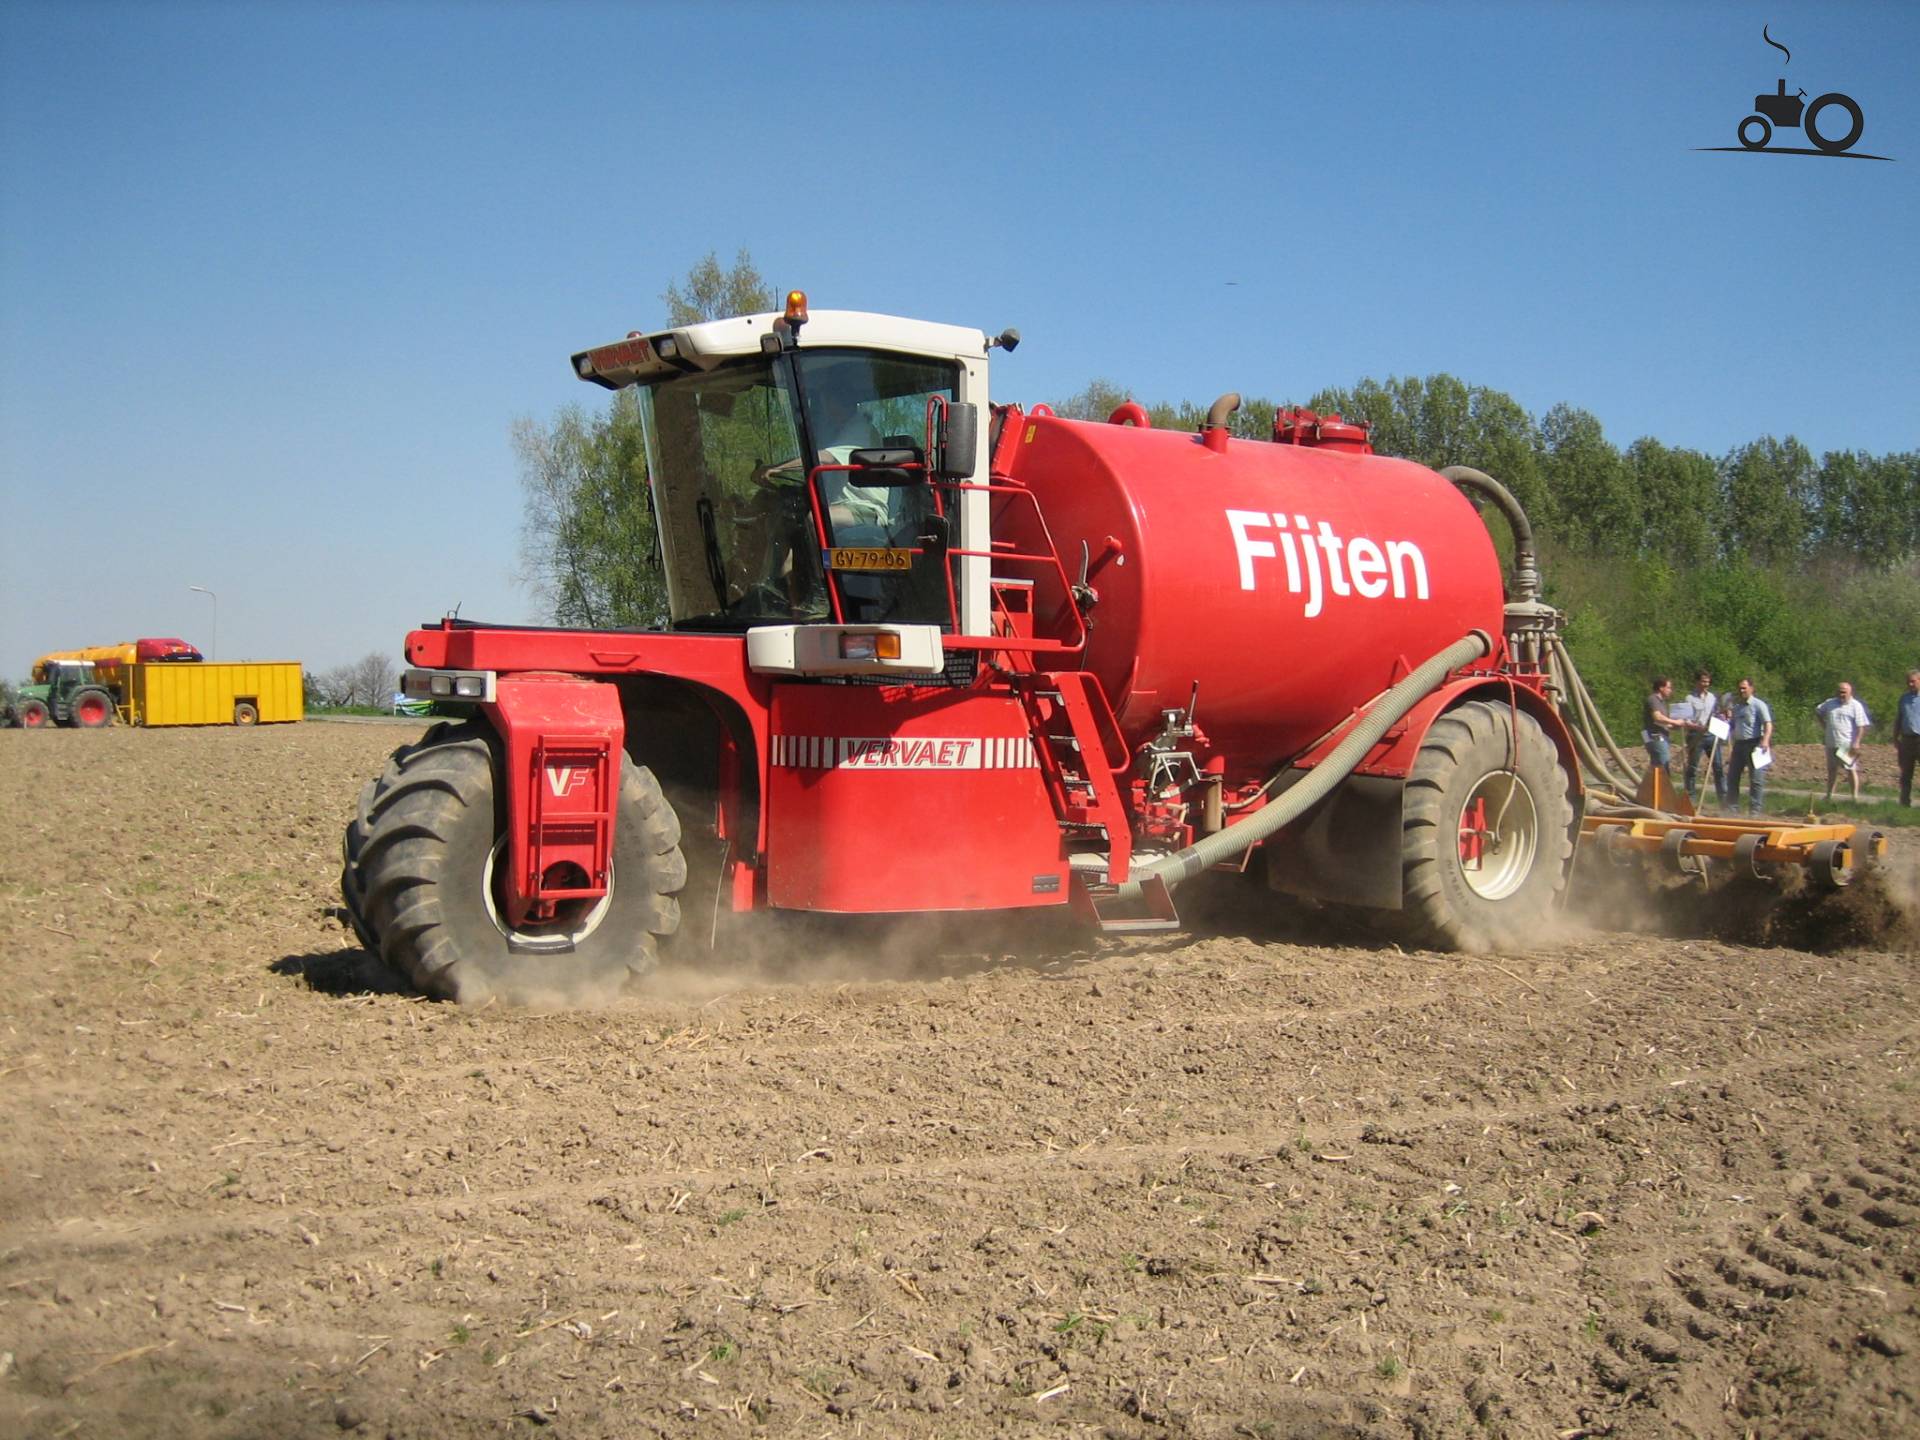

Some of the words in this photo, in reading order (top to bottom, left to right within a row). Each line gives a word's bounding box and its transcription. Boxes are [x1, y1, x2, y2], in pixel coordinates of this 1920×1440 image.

[836, 551, 905, 567] GV-79-06
[1225, 509, 1430, 618] Fijten
[846, 739, 974, 767] VERVAET
[546, 766, 590, 796] VF
